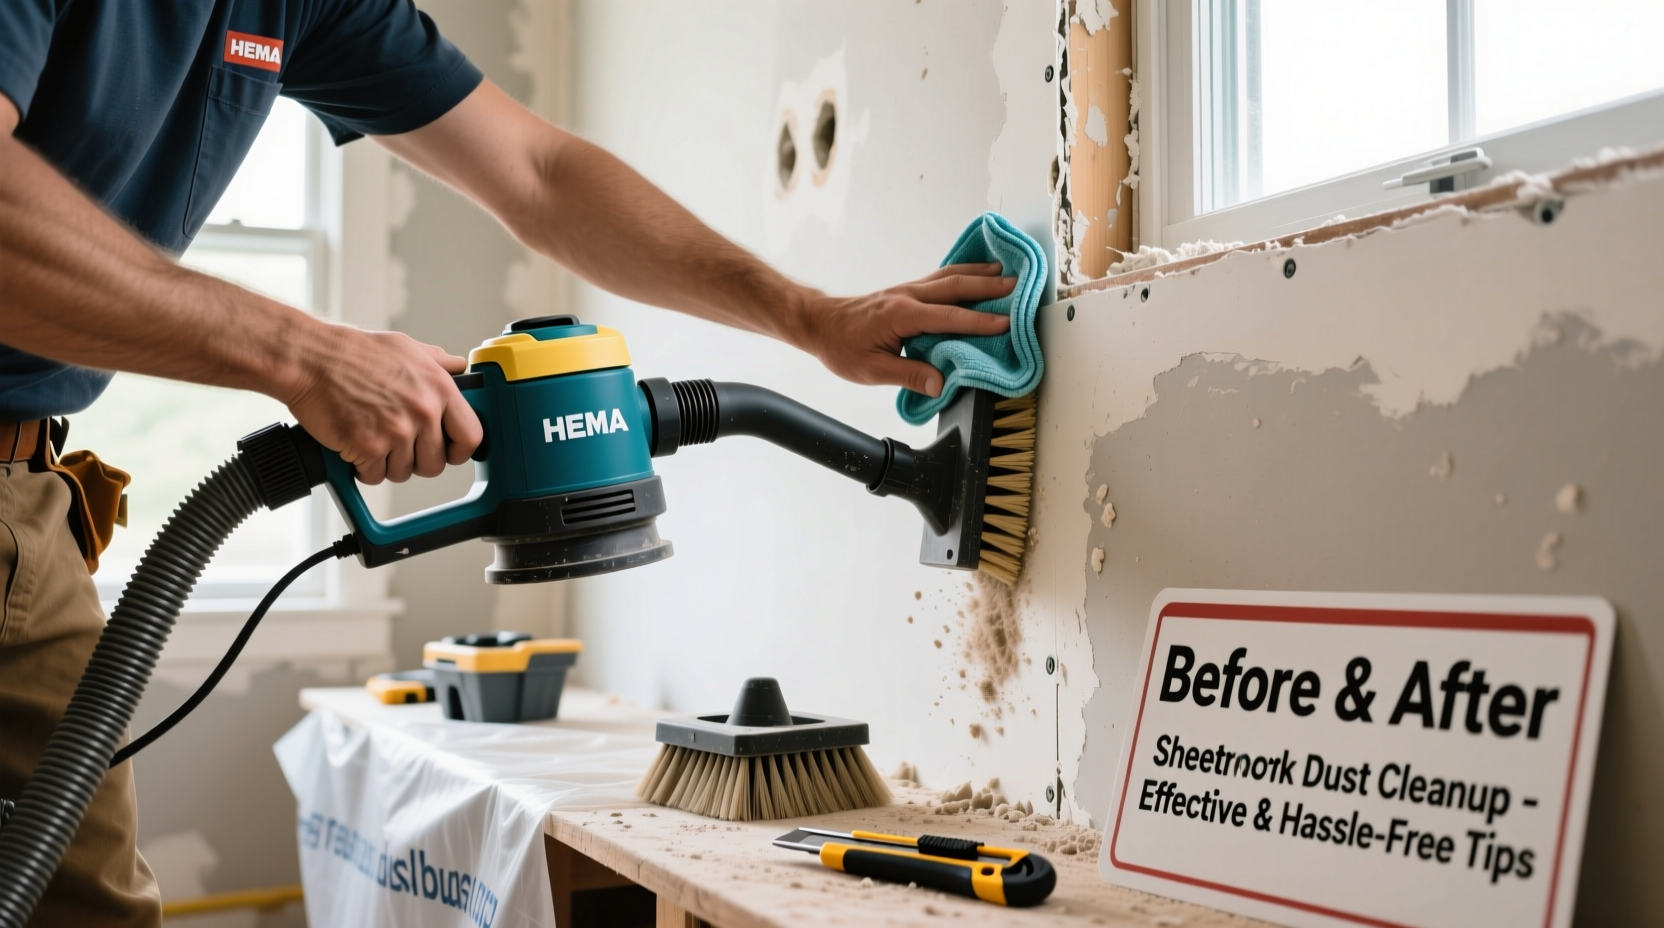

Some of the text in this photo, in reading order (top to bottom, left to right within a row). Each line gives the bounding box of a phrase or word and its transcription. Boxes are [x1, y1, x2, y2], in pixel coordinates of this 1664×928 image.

[231, 38, 281, 65] HEMA
[542, 408, 629, 443] HEMA
[1159, 644, 1561, 740] Before & After
[1302, 753, 1371, 797] Dust
[1377, 762, 1512, 826] Cleanup
[1138, 778, 1536, 885] Effective & Hassle-Free Tips
